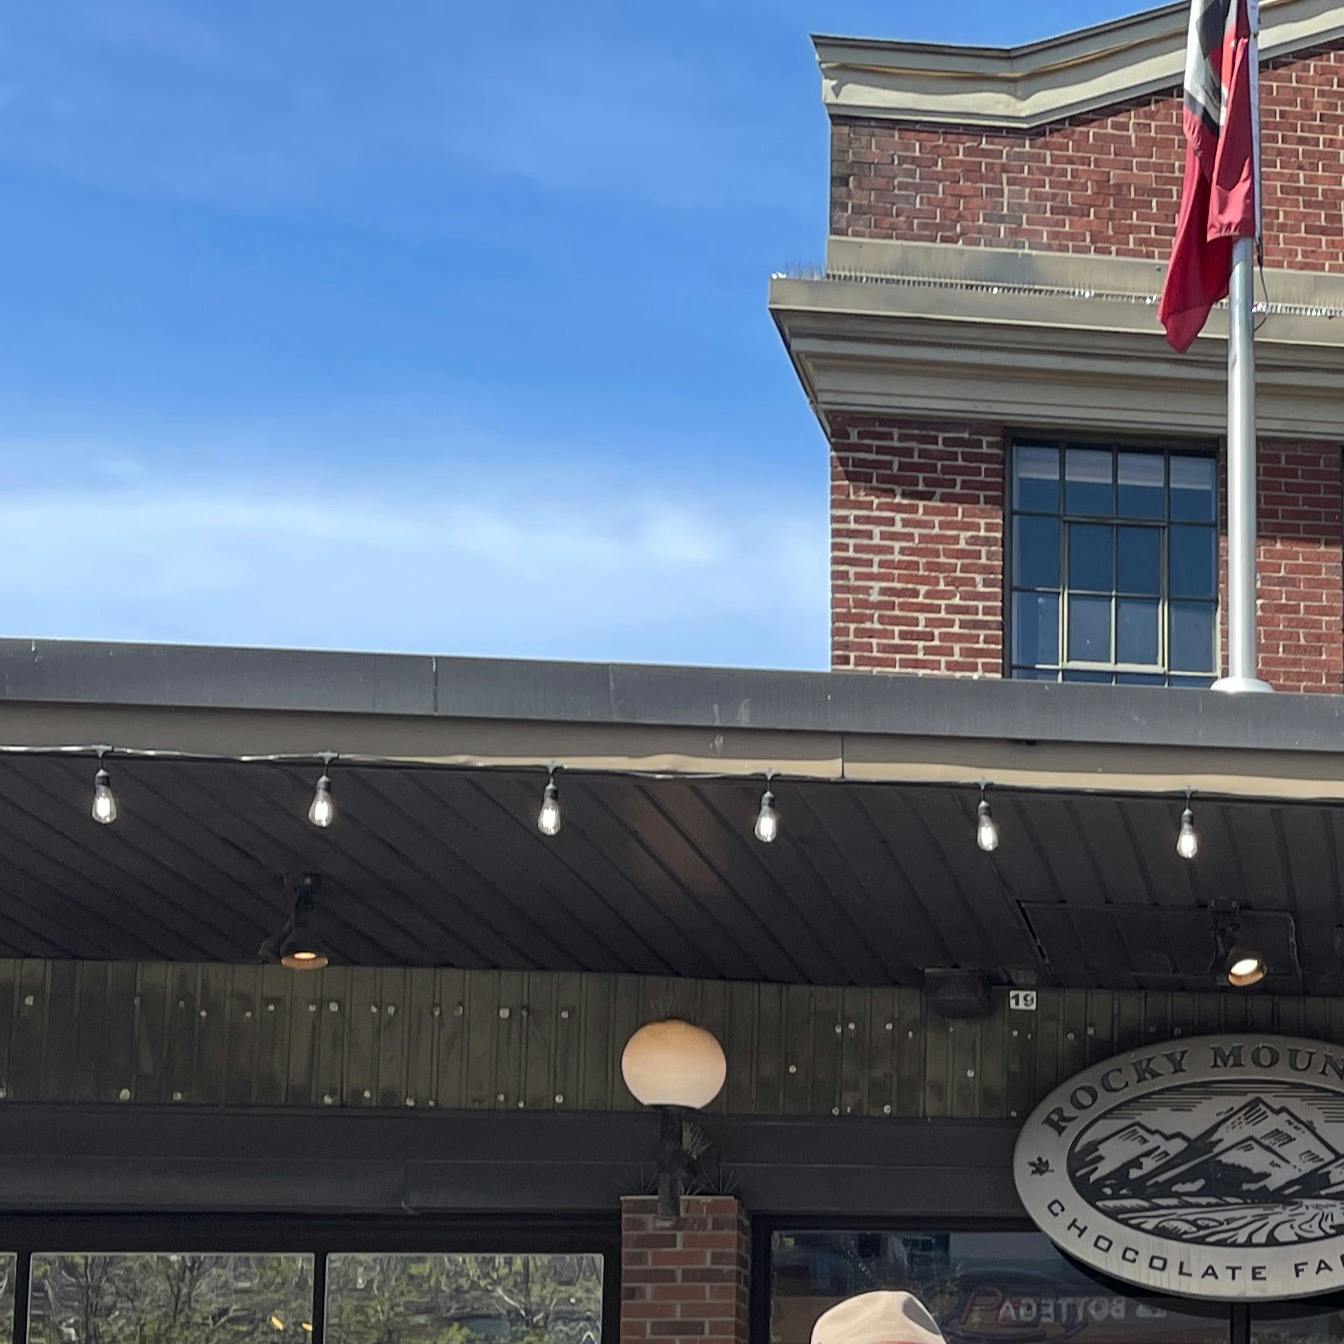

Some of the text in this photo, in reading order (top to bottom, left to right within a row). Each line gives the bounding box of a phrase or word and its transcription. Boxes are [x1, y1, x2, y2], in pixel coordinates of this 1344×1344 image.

[1011, 993, 1034, 1008] 19
[1041, 1048, 1191, 1138] ROCKY
[1046, 1198, 1268, 1282] CHOCOLATE
